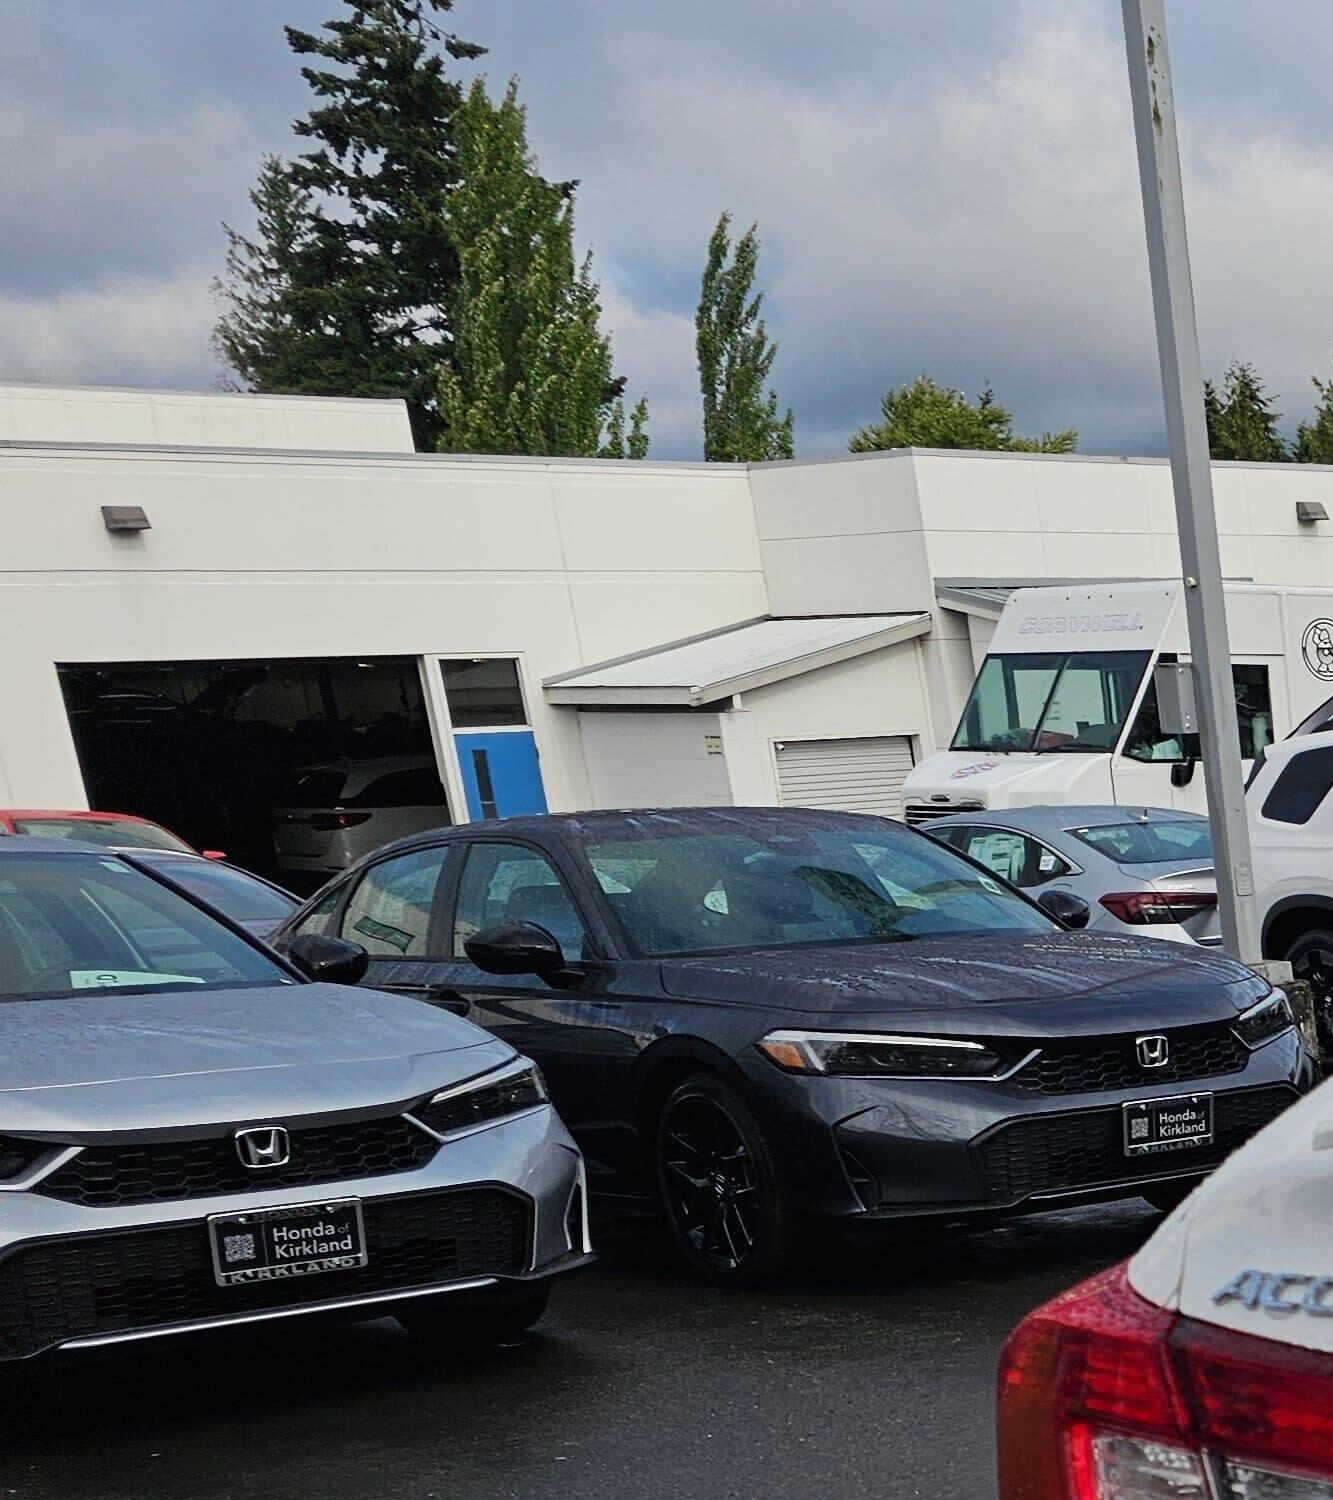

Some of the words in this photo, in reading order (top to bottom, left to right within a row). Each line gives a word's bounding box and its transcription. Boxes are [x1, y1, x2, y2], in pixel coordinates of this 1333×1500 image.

[1159, 1109, 1196, 1124] Honda
[1160, 1120, 1205, 1137] Kirkland
[272, 1222, 335, 1242] Honda
[338, 1223, 350, 1233] of
[274, 1235, 352, 1259] Kirkland
